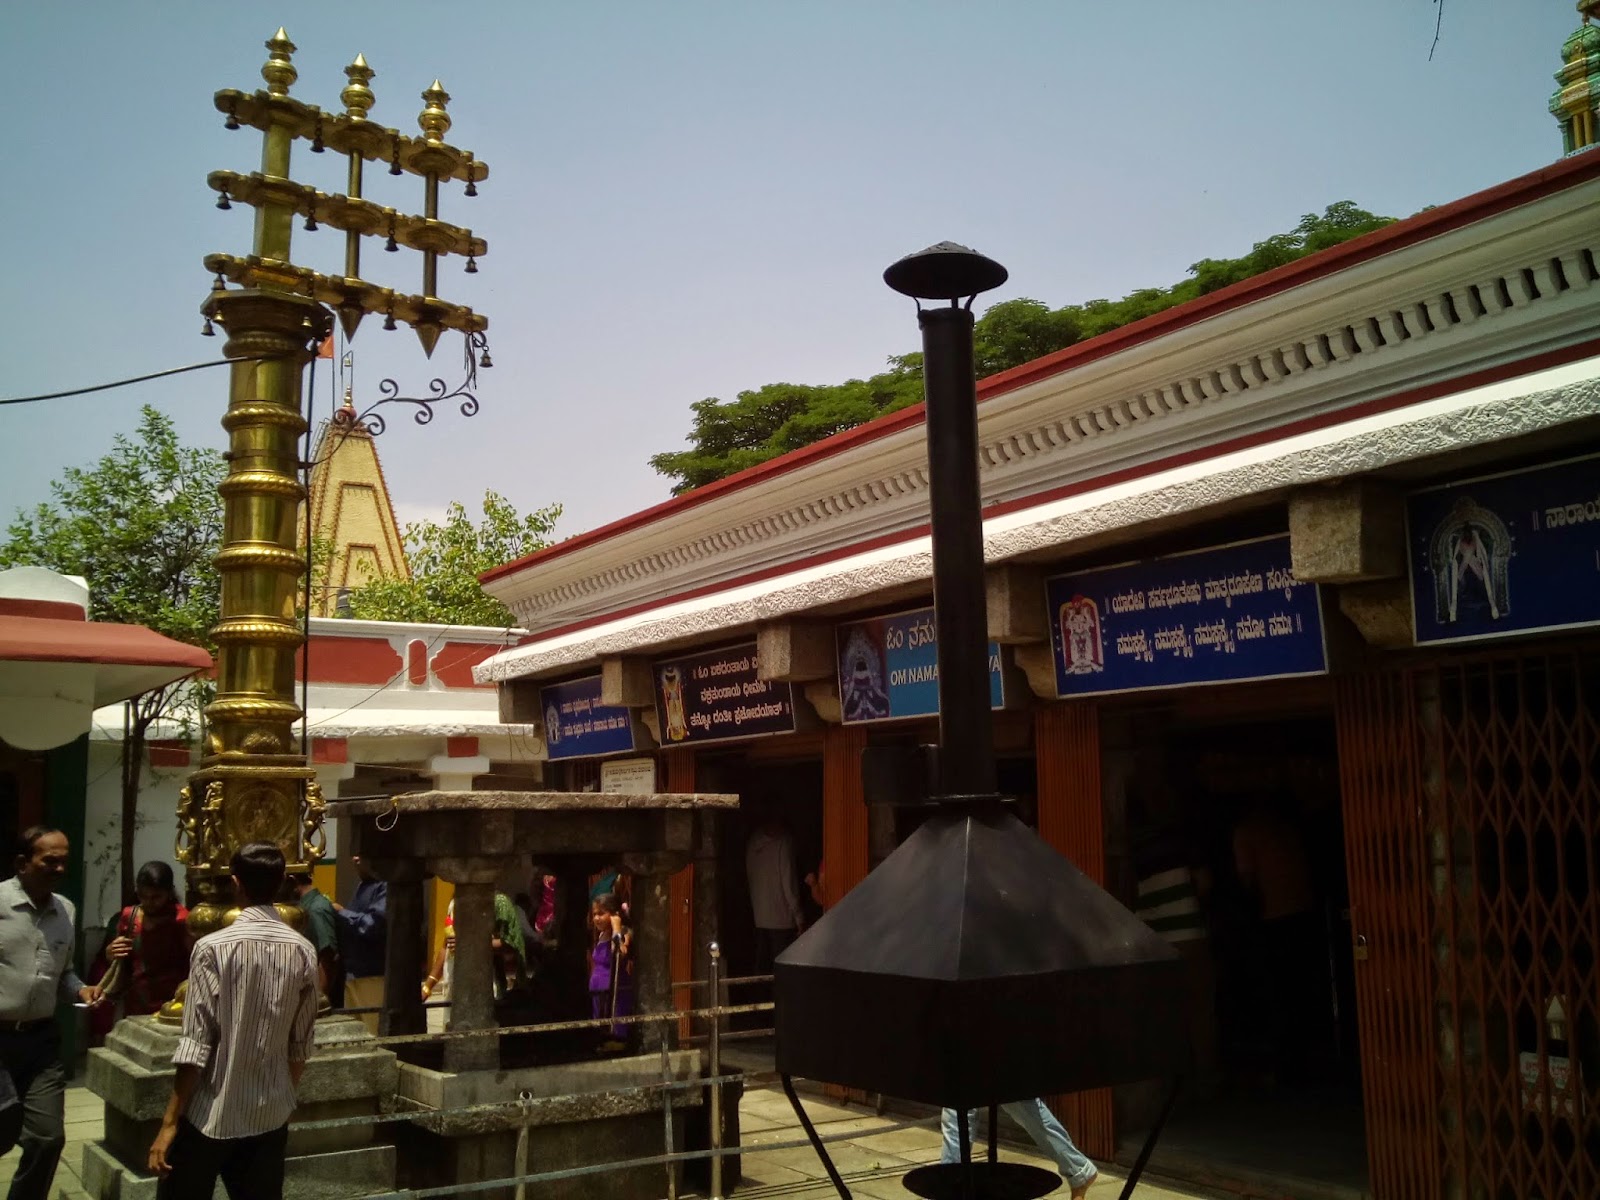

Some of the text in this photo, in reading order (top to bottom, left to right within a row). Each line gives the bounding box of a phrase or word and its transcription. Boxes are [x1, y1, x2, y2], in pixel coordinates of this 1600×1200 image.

[886, 618, 936, 650] ಓಂ ನಮ
[1236, 614, 1265, 640] ನಮೋ
[698, 666, 708, 679] ಓಂ
[890, 668, 906, 686] OM
